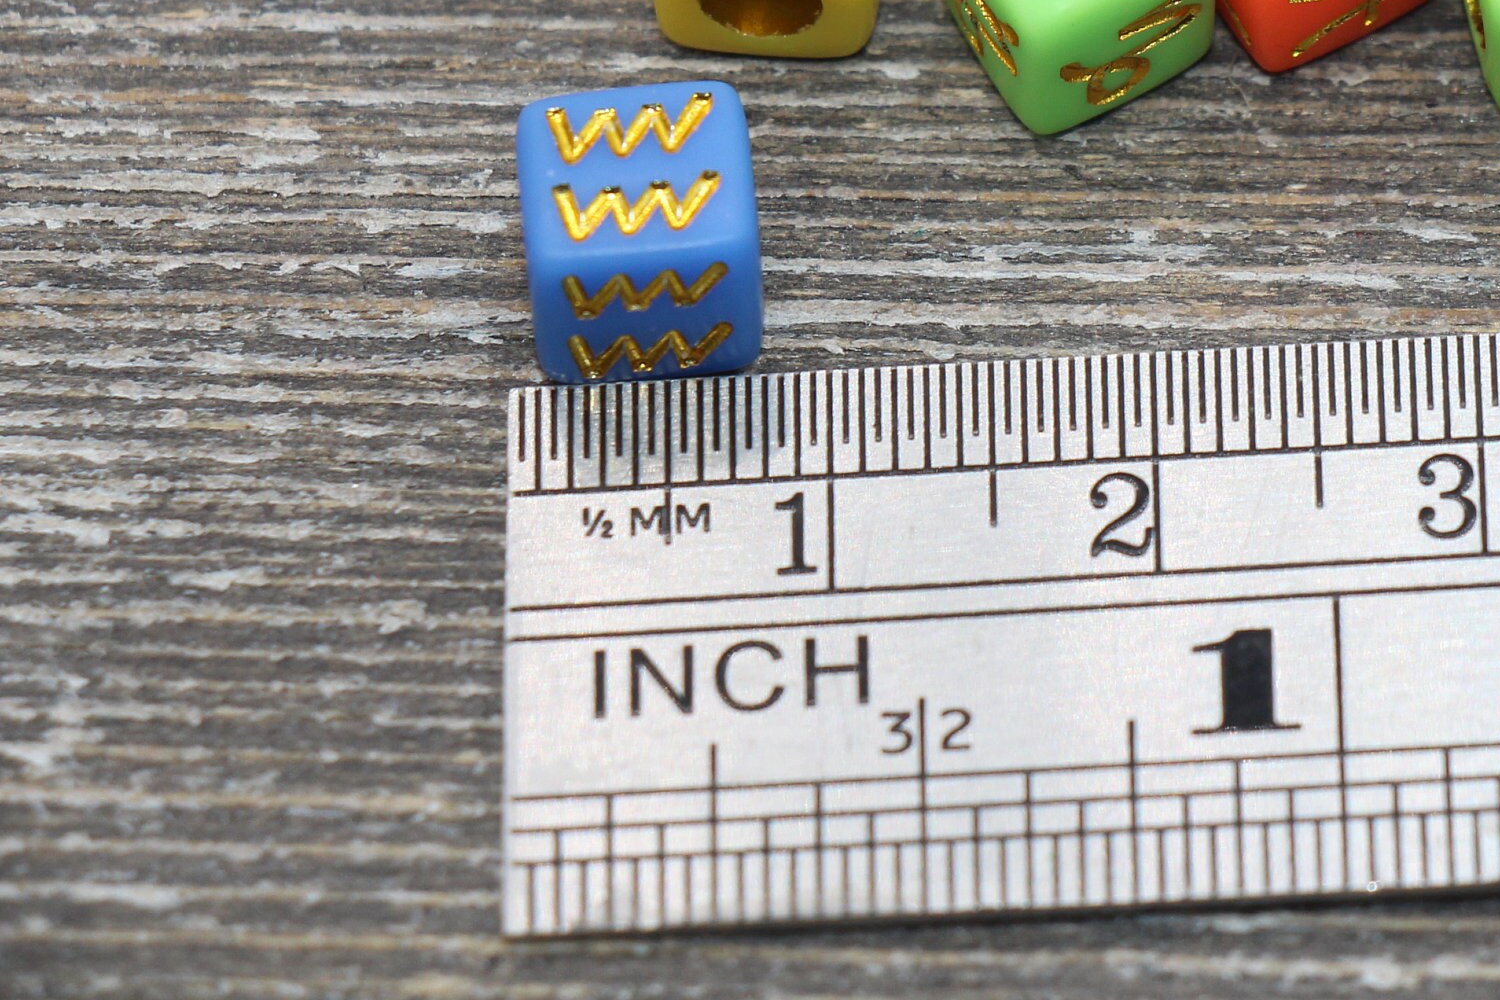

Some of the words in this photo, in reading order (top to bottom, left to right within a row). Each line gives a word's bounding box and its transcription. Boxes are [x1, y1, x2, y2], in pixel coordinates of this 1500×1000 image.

[629, 502, 712, 537] MM
[775, 491, 818, 575] 1
[1089, 471, 1156, 557] 2
[1417, 452, 1478, 540] 3
[591, 634, 870, 719] INCH
[1191, 628, 1303, 735] 1
